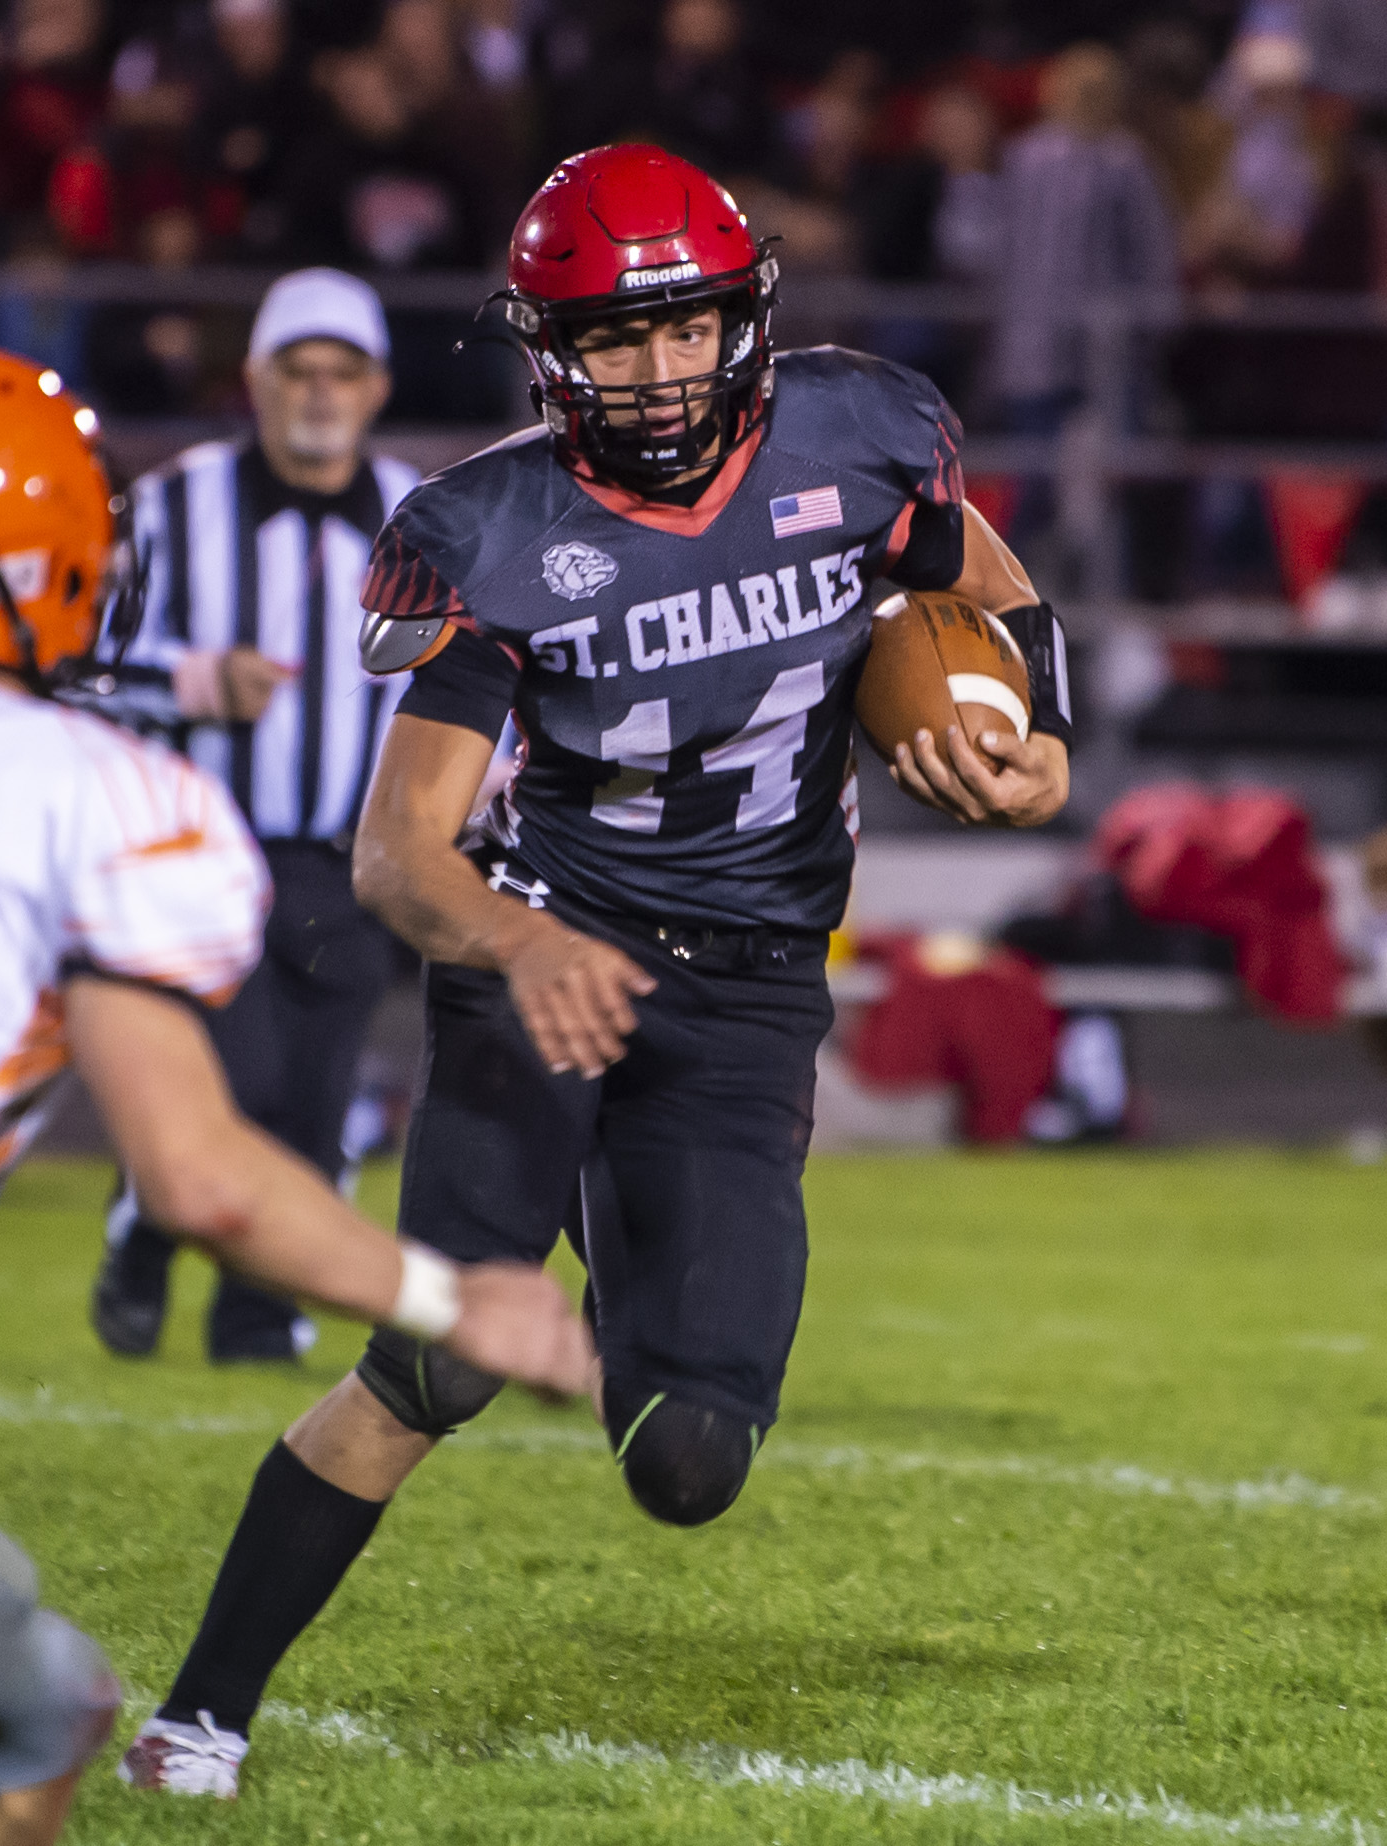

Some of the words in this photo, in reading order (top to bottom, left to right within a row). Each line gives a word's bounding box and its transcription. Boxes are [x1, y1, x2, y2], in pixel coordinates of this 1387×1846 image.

[528, 615, 620, 679] ST.
[624, 544, 867, 673] CHARLES
[590, 660, 826, 835] 14
